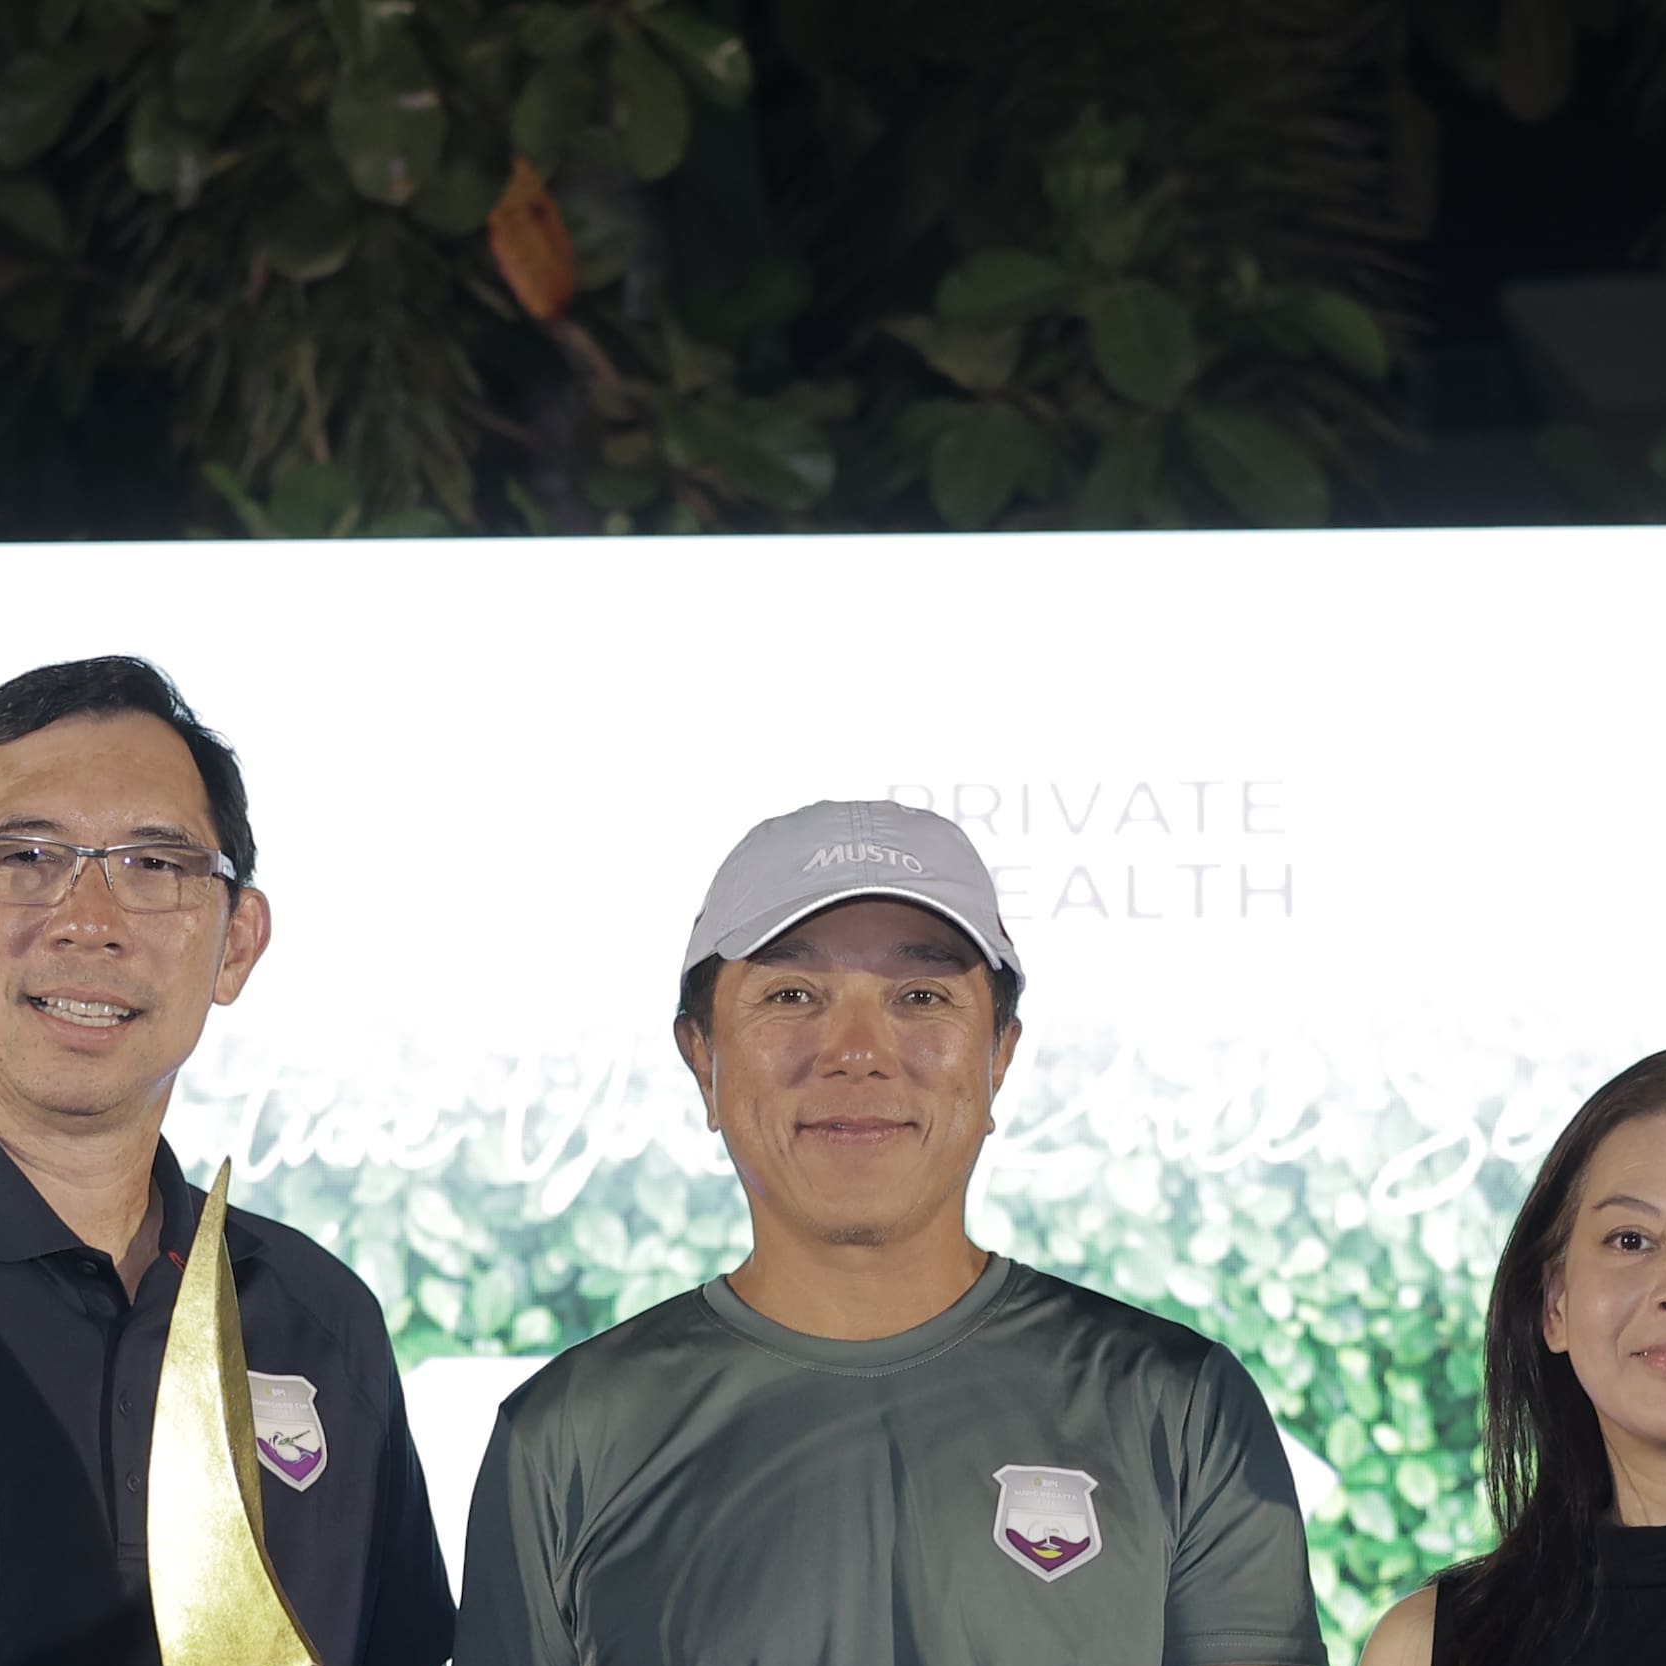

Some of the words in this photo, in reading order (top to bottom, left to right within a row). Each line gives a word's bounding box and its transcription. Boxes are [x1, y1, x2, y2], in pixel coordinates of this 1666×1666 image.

[887, 780, 1286, 836] PRIVATE
[801, 843, 923, 873] MUSTO
[990, 863, 1293, 919] EALTH
